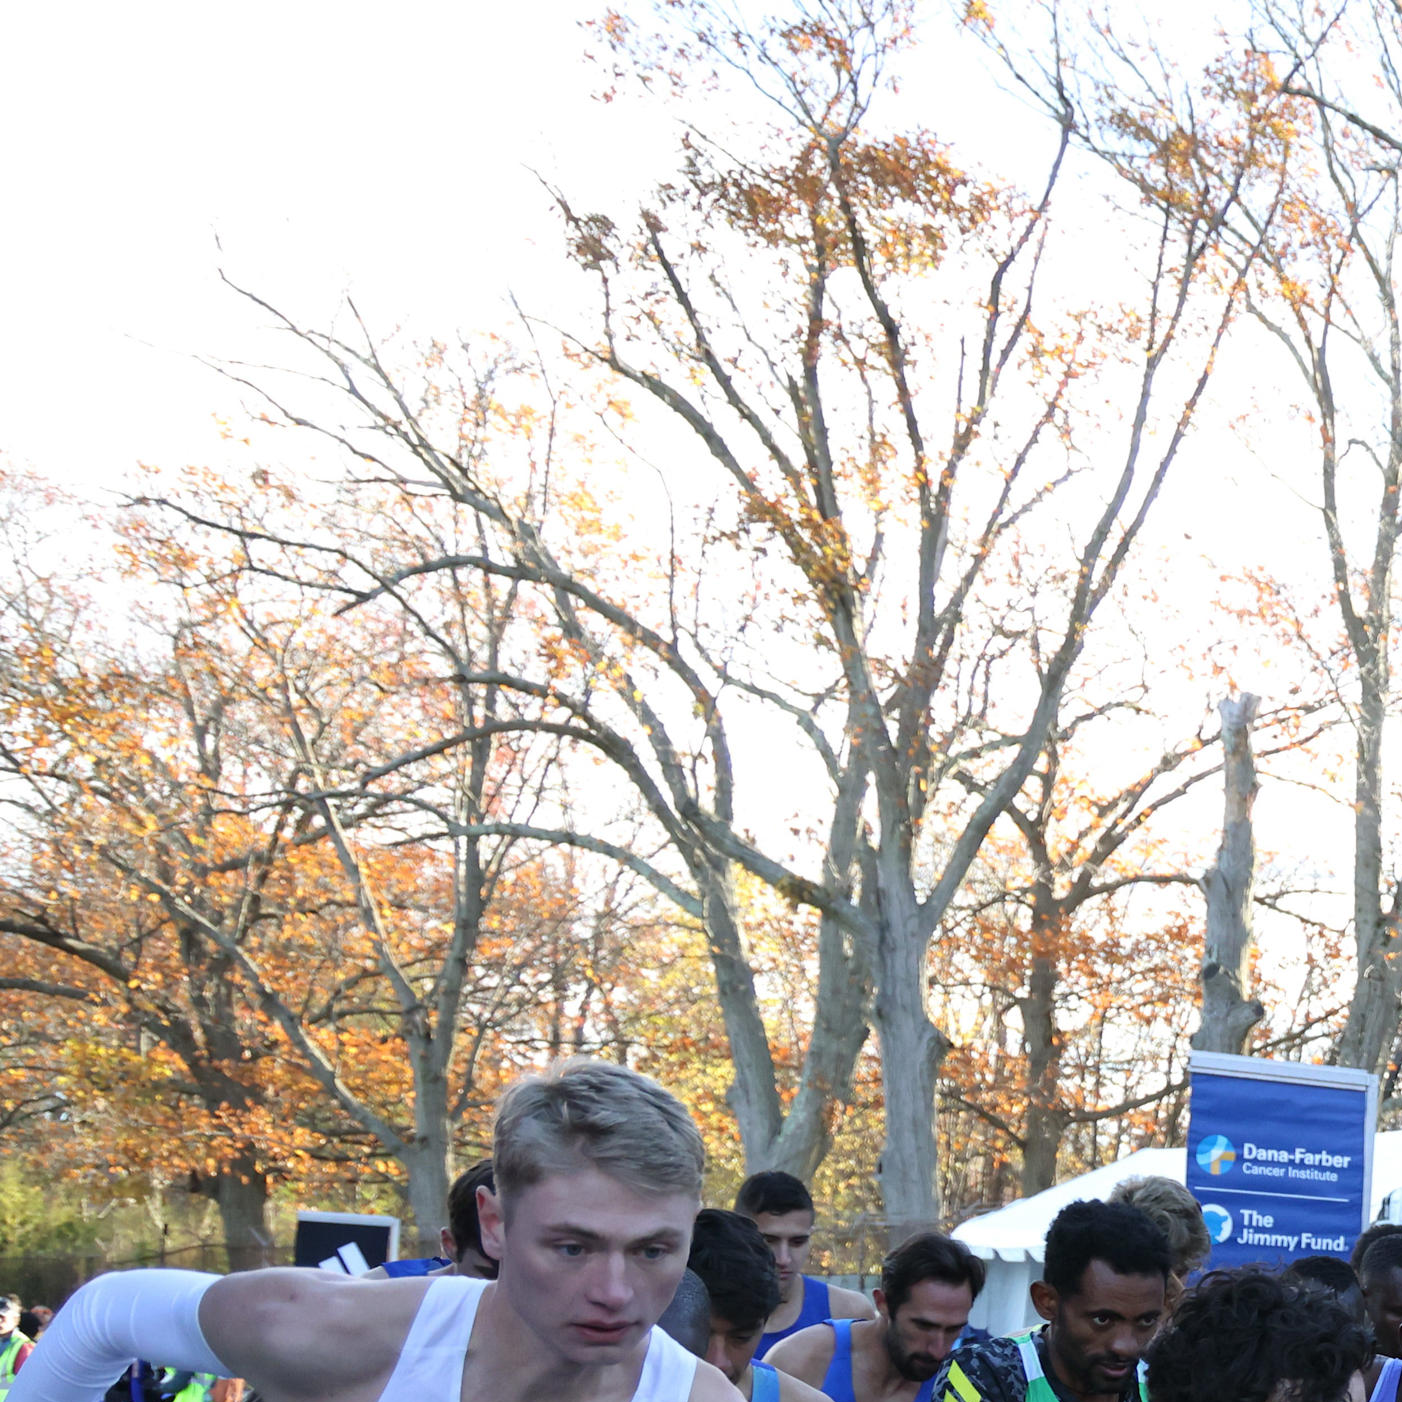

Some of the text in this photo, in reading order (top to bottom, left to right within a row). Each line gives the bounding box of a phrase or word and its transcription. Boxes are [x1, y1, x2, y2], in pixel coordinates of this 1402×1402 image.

[1243, 1143, 1352, 1169] Dana-Farber
[1242, 1162, 1339, 1182] Cancer Institute
[1239, 1209, 1275, 1229] The
[1236, 1228, 1299, 1252] Jimmy
